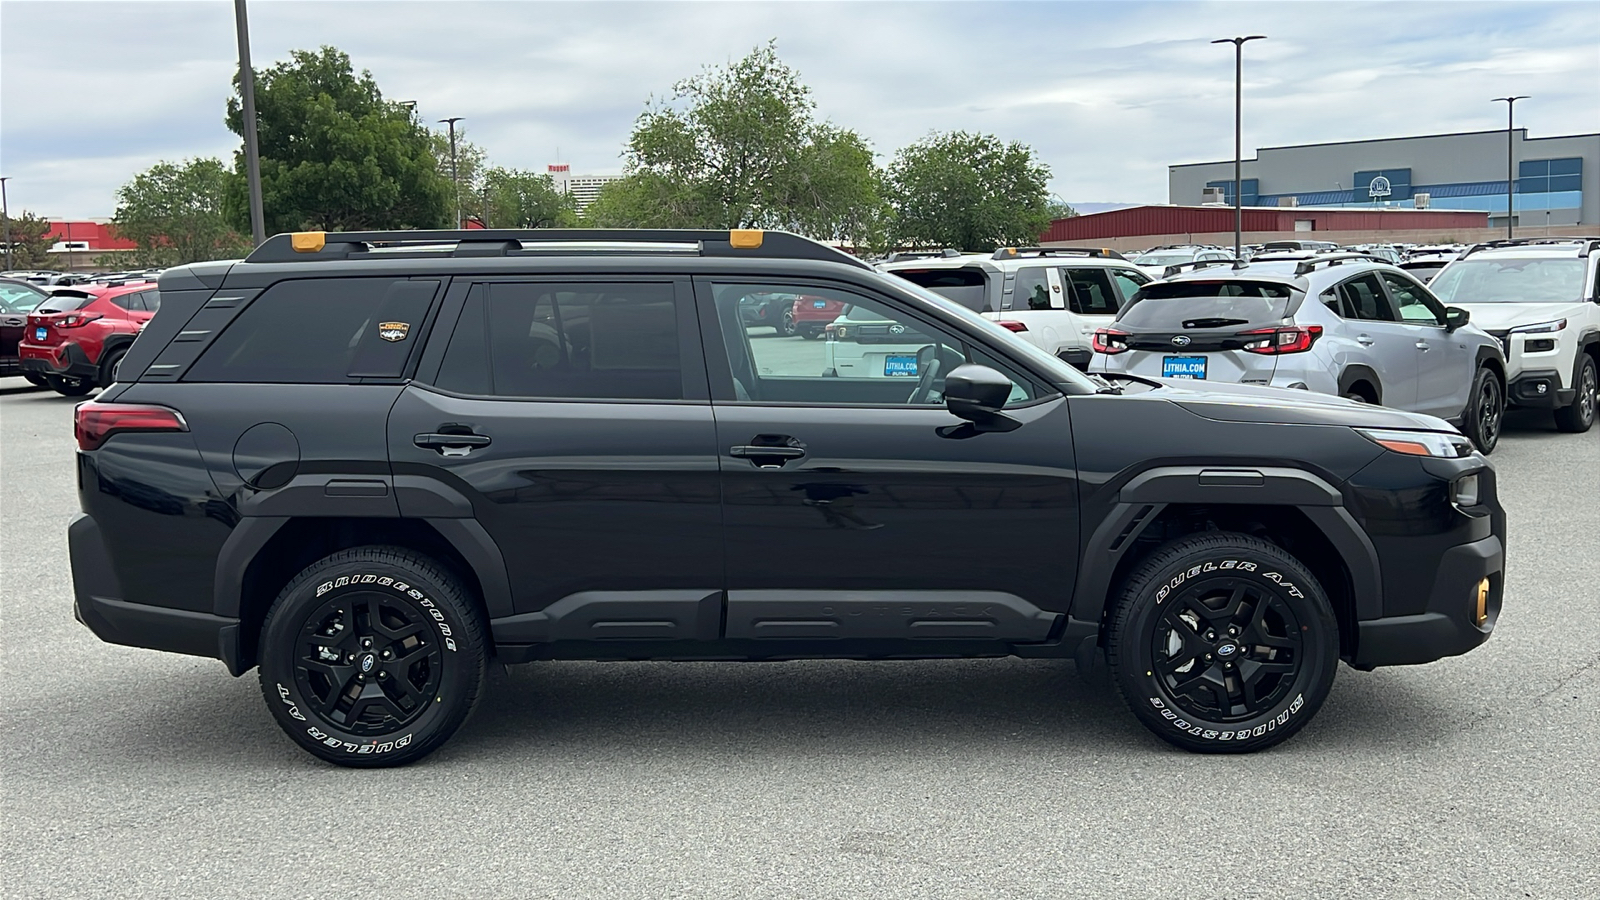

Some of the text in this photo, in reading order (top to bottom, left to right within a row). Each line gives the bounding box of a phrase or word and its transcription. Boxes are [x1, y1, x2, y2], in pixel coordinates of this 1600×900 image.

[886, 362, 917, 371] LITHIA.COM
[1164, 363, 1205, 373] LITHIA.COM
[1156, 560, 1305, 605] DUELER A/T
[315, 574, 457, 652] BRIDGESTONE
[821, 606, 994, 616] OUTBACK
[276, 683, 413, 754] DUELER A/T
[1149, 693, 1305, 741] BRIDGESTONE
